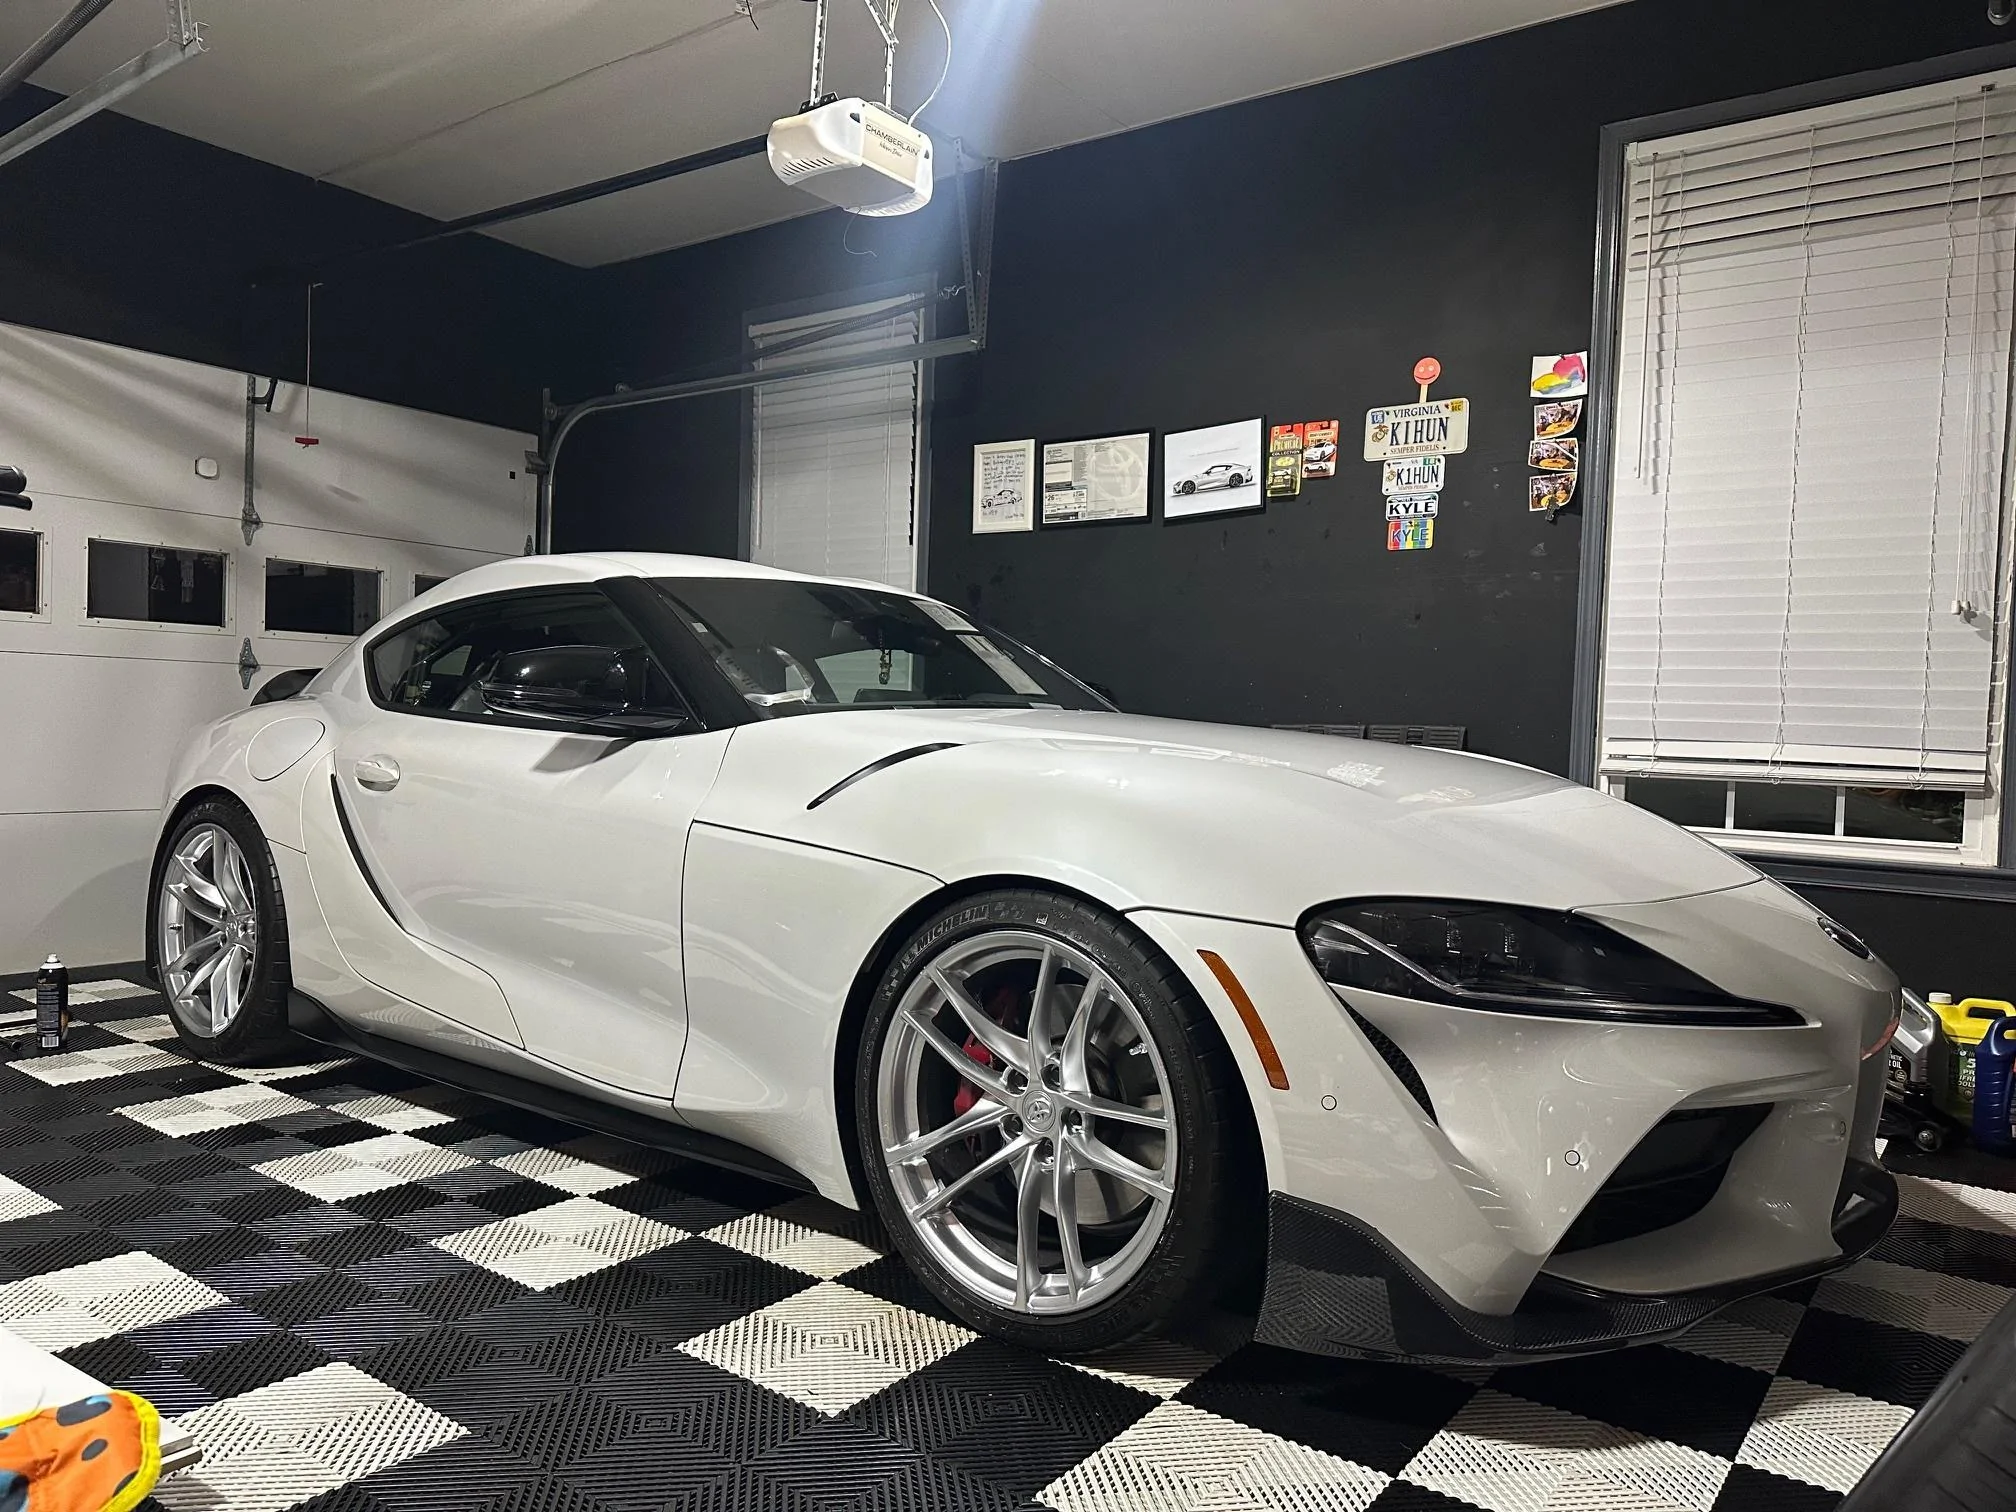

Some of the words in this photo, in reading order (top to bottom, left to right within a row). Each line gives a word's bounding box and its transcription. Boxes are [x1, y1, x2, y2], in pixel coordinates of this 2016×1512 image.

[865, 123, 921, 156] CHAMBERLAIN
[1393, 404, 1441, 419] VIRGINIA
[1390, 446, 1415, 455] SEMPER
[1416, 444, 1440, 452] FIDELIS
[1396, 464, 1439, 486] K1HUN
[1389, 501, 1435, 515] KYLE
[1392, 528, 1429, 543] KYLE
[917, 904, 990, 954] MICHELIN
[1892, 1060, 1902, 1069] OIL
